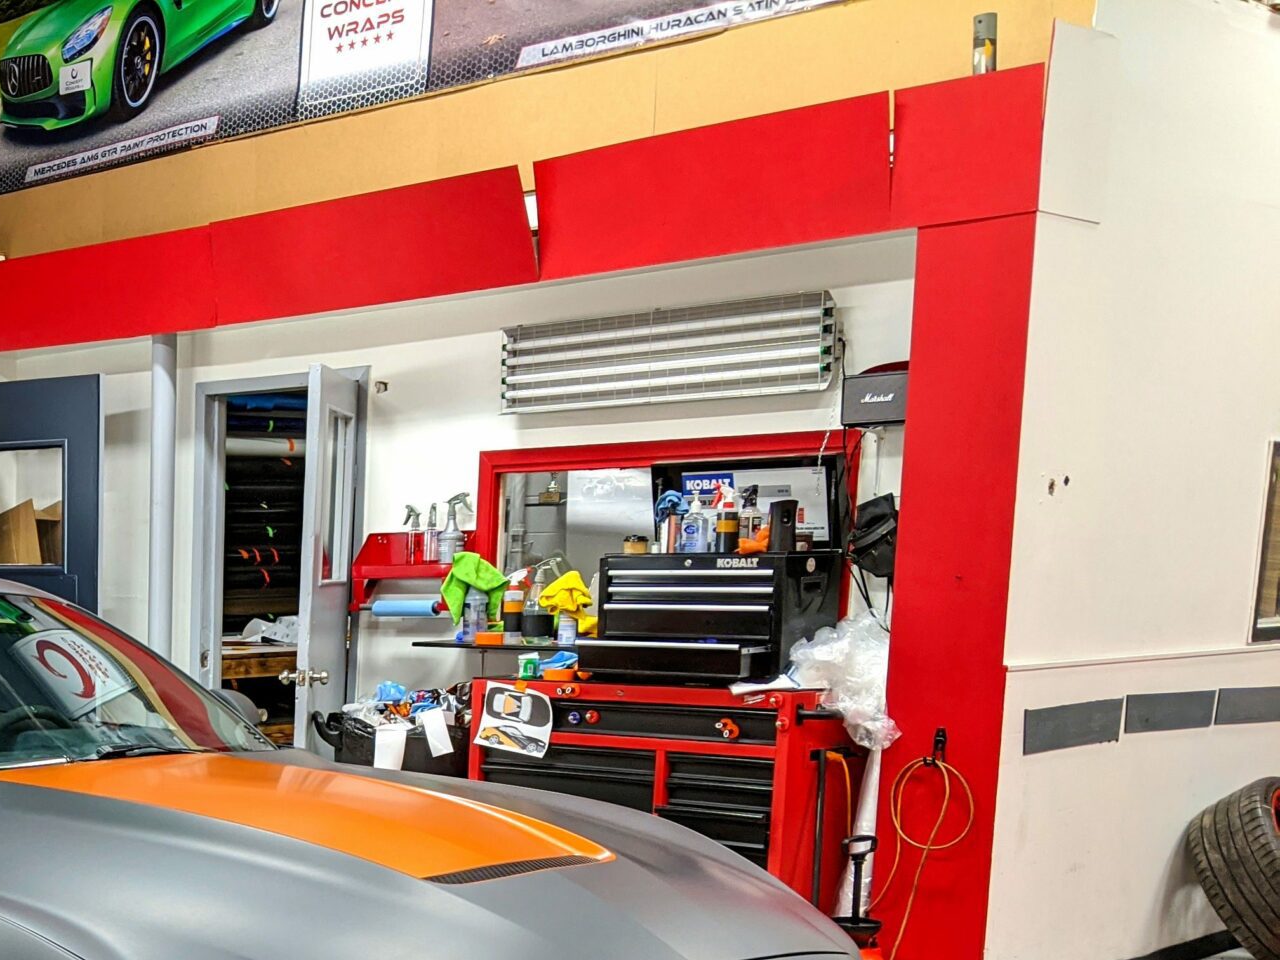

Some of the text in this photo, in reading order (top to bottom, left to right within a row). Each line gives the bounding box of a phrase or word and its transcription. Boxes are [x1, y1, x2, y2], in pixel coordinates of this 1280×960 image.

[320, 0, 391, 18] CONC
[328, 8, 405, 40] WRAPS
[541, 0, 780, 57] LAMBORGHINI HURACAN SATIN
[33, 122, 208, 177] MERCEDES AMG GTR PAINT PROTECTION
[716, 558, 759, 568] KOBALT
